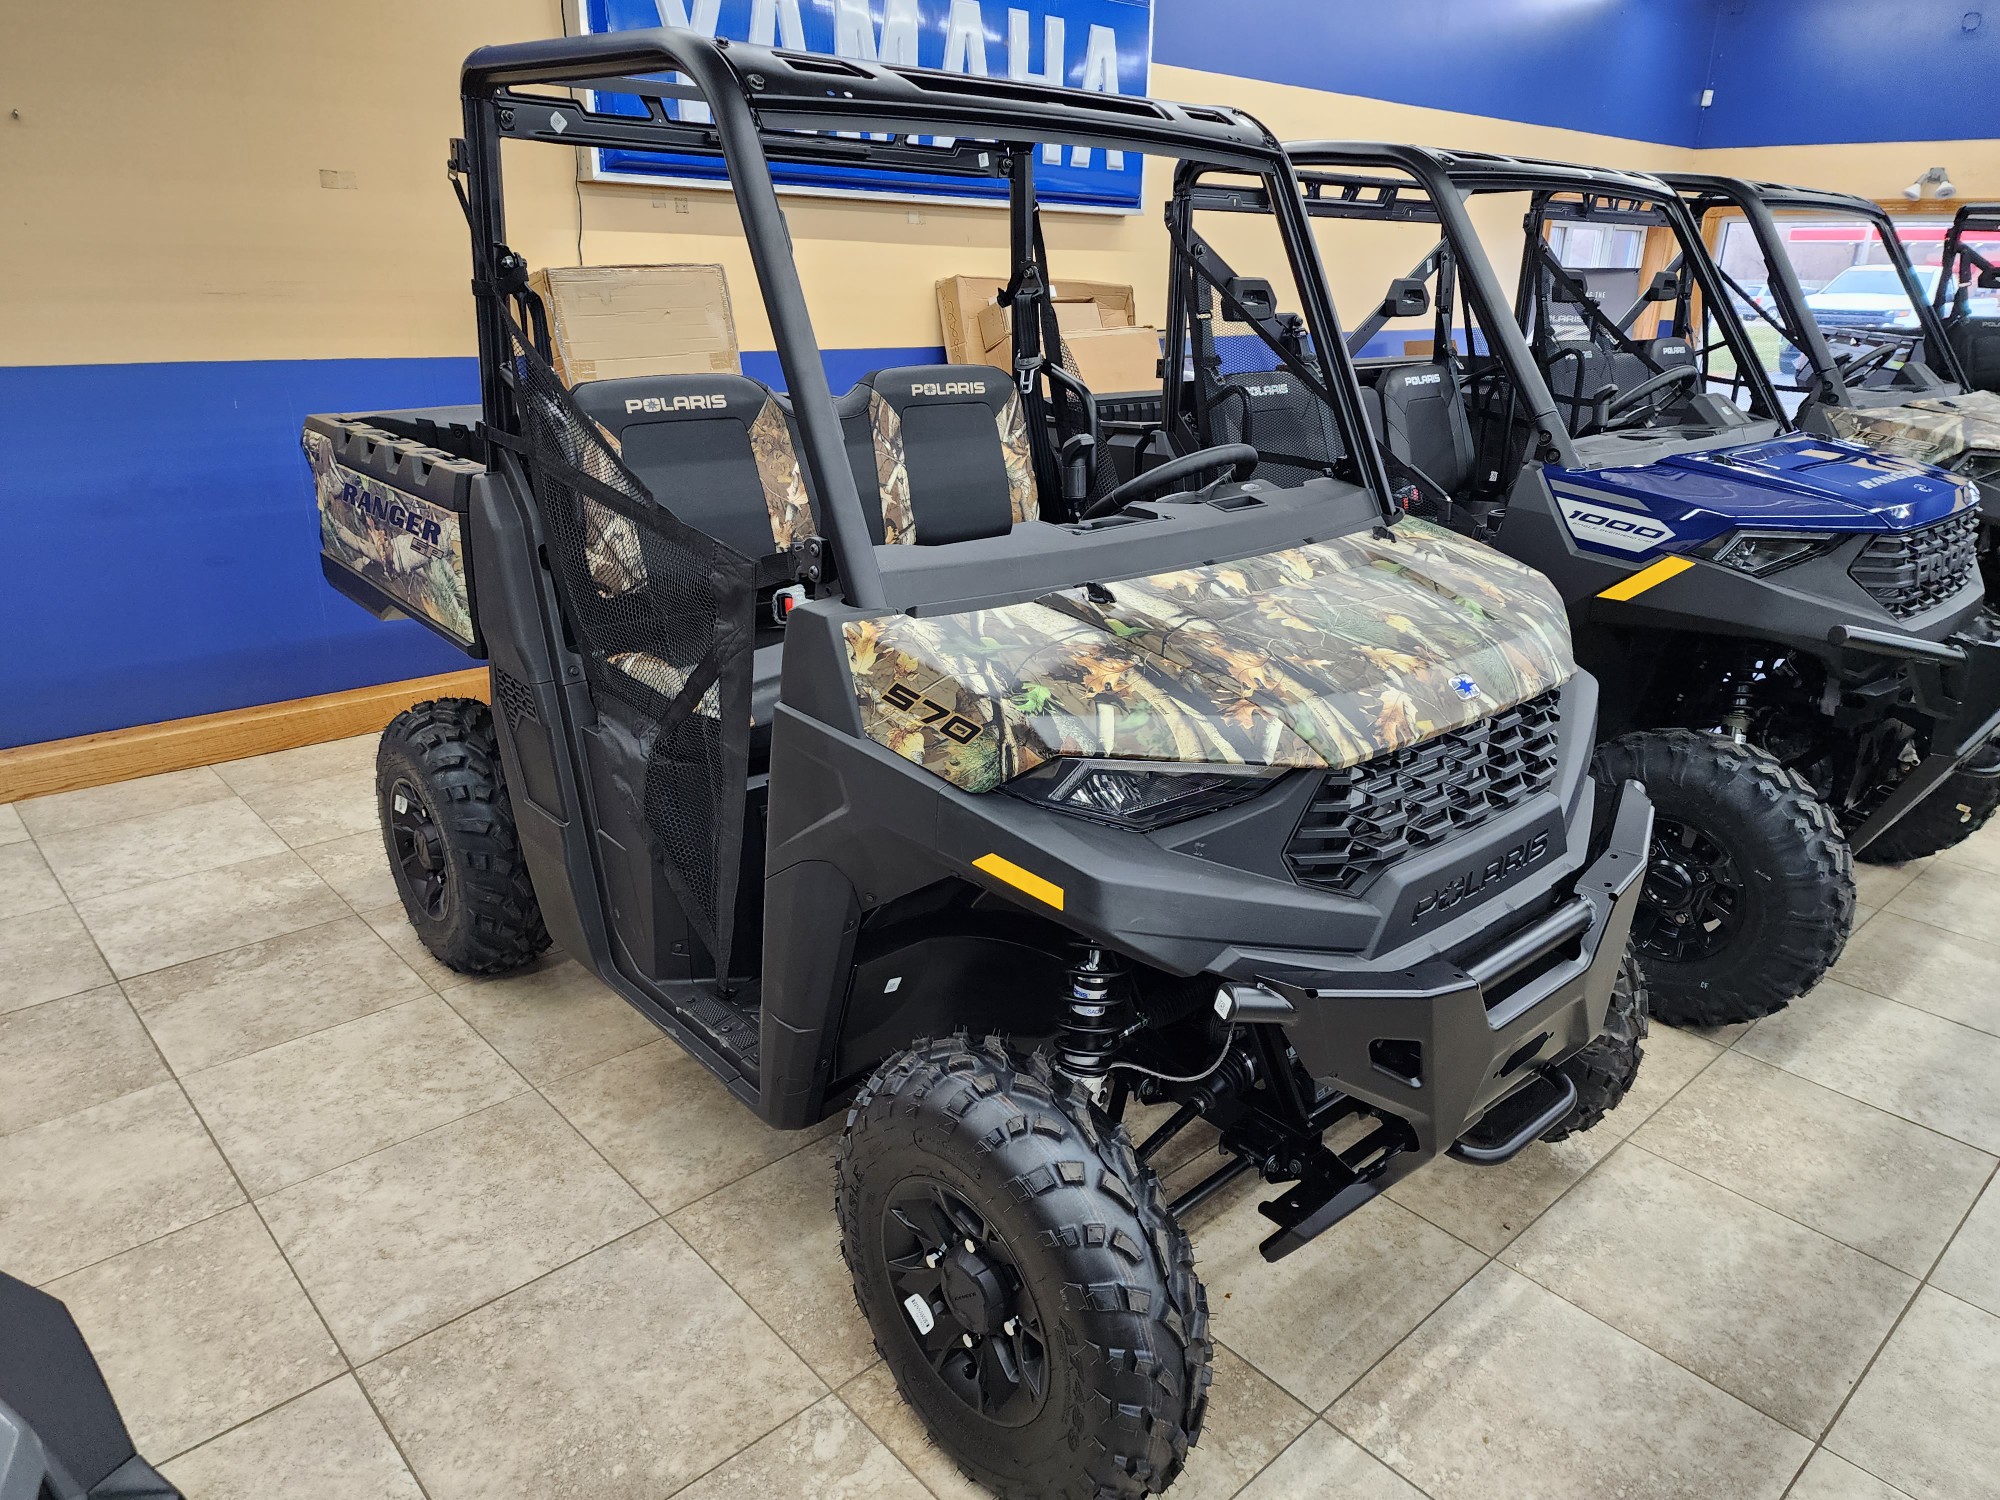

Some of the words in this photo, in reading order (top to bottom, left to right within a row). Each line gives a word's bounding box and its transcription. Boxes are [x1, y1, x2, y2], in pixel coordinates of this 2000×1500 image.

[1662, 346, 1686, 355] POLARIS
[910, 381, 986, 397] POLARIS
[1404, 373, 1441, 387] POLARIS
[625, 394, 728, 414] POLARIS
[1854, 430, 1940, 452] 1000
[342, 482, 442, 546] RANGER
[1568, 509, 1666, 539] 1000
[410, 536, 445, 560] SP
[881, 681, 983, 746] 570
[1410, 827, 1550, 927] POLARIS
